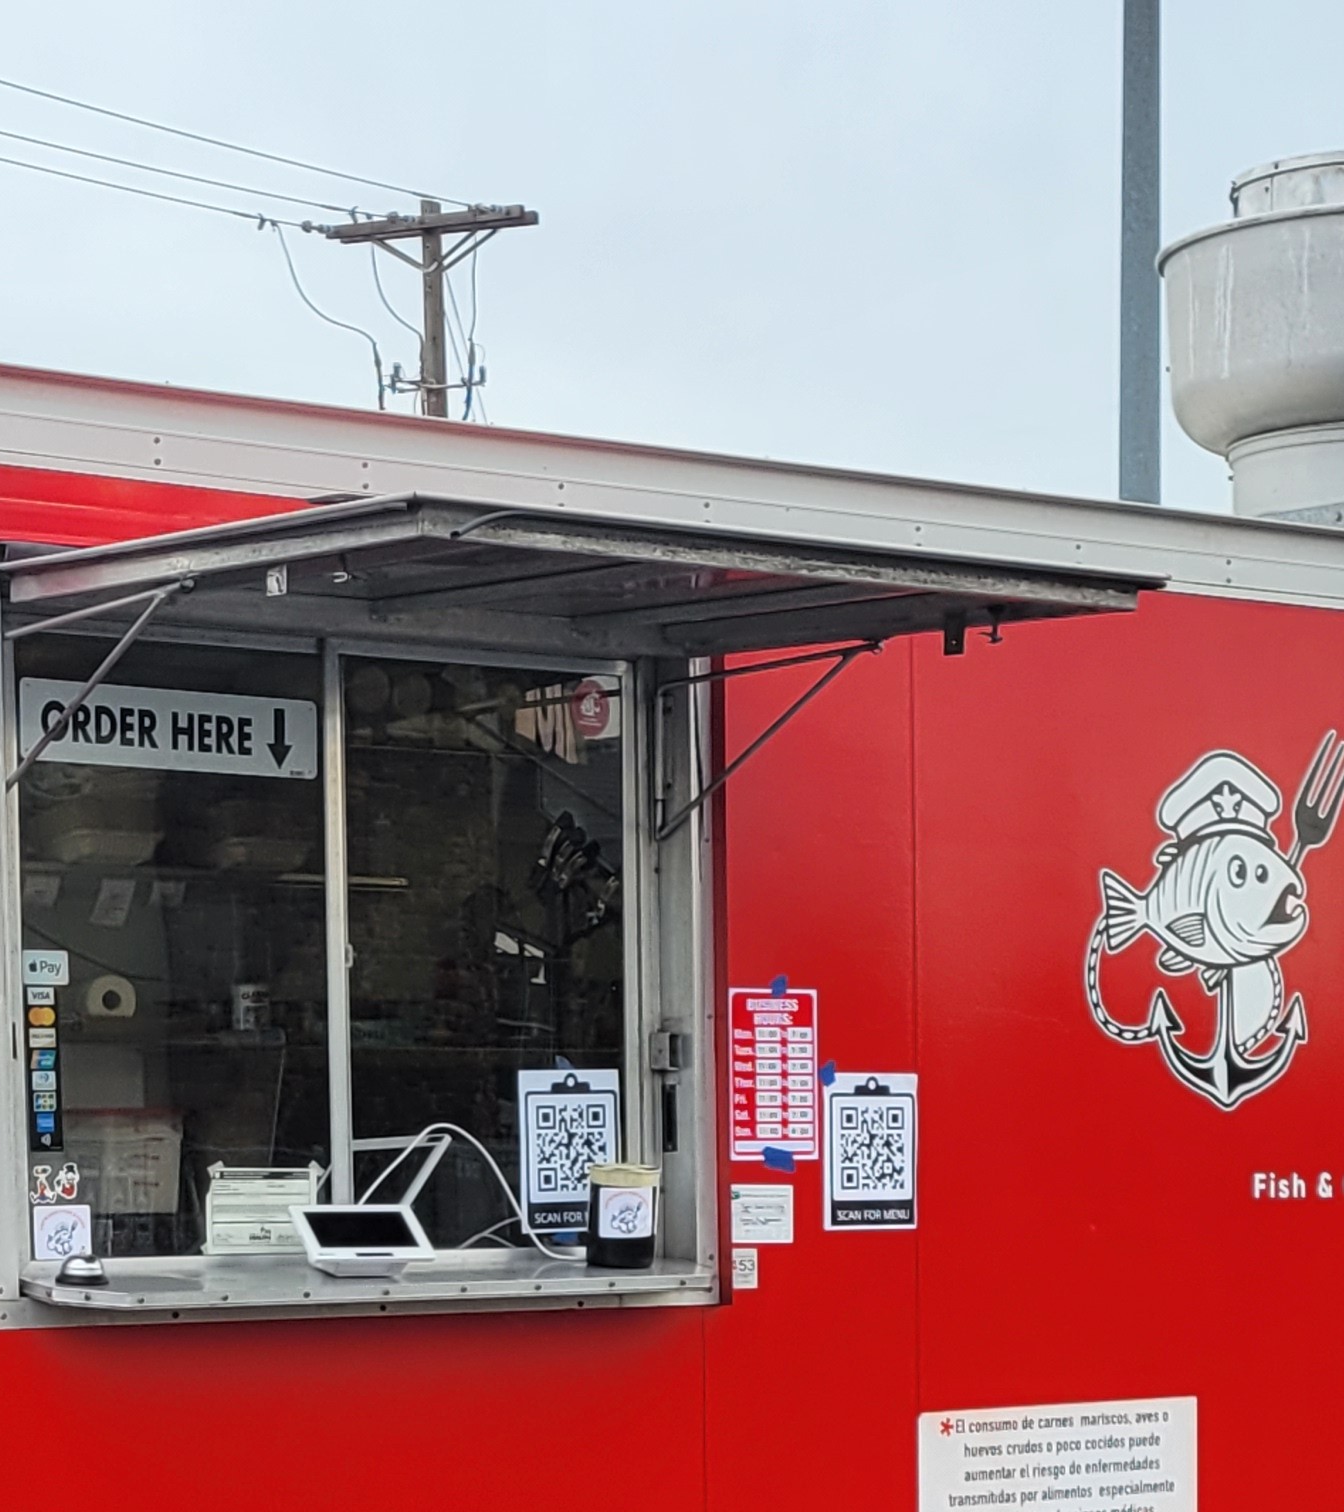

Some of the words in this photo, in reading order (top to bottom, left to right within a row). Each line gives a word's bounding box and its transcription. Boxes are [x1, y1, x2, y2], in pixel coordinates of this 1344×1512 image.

[41, 700, 158, 749] ORDER
[171, 711, 253, 756] HERE
[39, 960, 62, 977] Pay
[31, 991, 51, 1001] VISA
[1253, 1172, 1306, 1199] Fish
[1316, 1172, 1334, 1199] &
[534, 1212, 562, 1224] SCAN
[563, 1211, 583, 1223] FOR
[836, 1209, 862, 1221] SCAN
[863, 1208, 882, 1220] FOR
[883, 1208, 910, 1220] MENU
[956, 1419, 966, 1434] El
[969, 1419, 1018, 1434] consumo
[1022, 1415, 1035, 1430] de
[1038, 1416, 1074, 1429] carnes
[1135, 1411, 1160, 1424] aves
[1162, 1411, 1169, 1422] o
[964, 1443, 1003, 1458] huevos
[1006, 1439, 1043, 1455] crudos
[1046, 1441, 1053, 1453] o
[1056, 1439, 1081, 1456] poco
[1085, 1434, 1126, 1450] cocidos
[1128, 1432, 1161, 1452] puede
[964, 1466, 1016, 1482] aumentar
[1019, 1463, 1030, 1478] el
[1033, 1462, 1066, 1481] riesgo
[1069, 1460, 1082, 1475] de
[1084, 1455, 1161, 1474] enfermedades
[948, 1489, 1017, 1508] transmitidas
[1020, 1490, 1038, 1507] por
[1041, 1485, 1093, 1501] alimentos
[1099, 1479, 1175, 1501] especialmente
